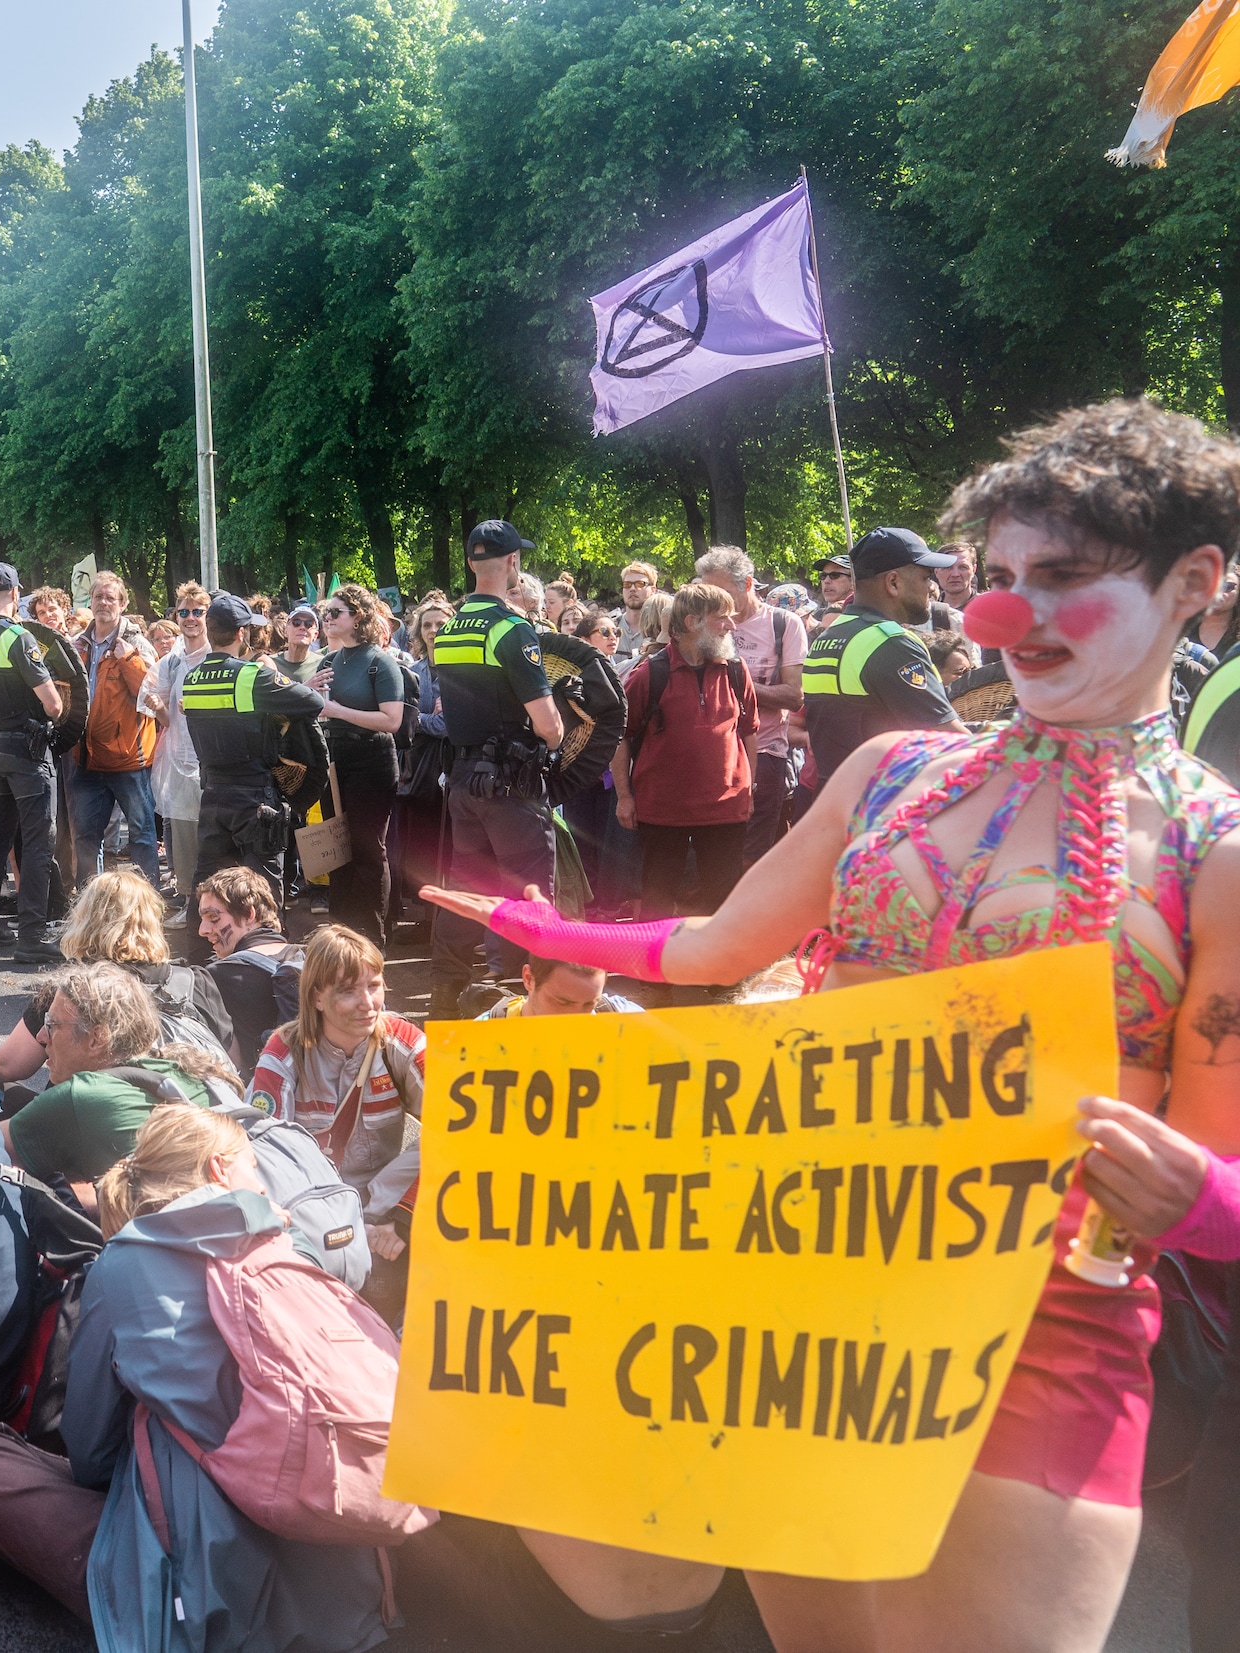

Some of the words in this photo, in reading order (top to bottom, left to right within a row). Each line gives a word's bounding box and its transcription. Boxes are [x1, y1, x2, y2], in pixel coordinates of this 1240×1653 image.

[808, 639, 838, 656] LITIE
[447, 1067, 600, 1139] STOP
[648, 1018, 1030, 1139] TRAETING
[436, 1170, 710, 1252] CLIMATE
[428, 1300, 571, 1408] LIKE
[615, 1321, 1009, 1446] CRIMINALS
